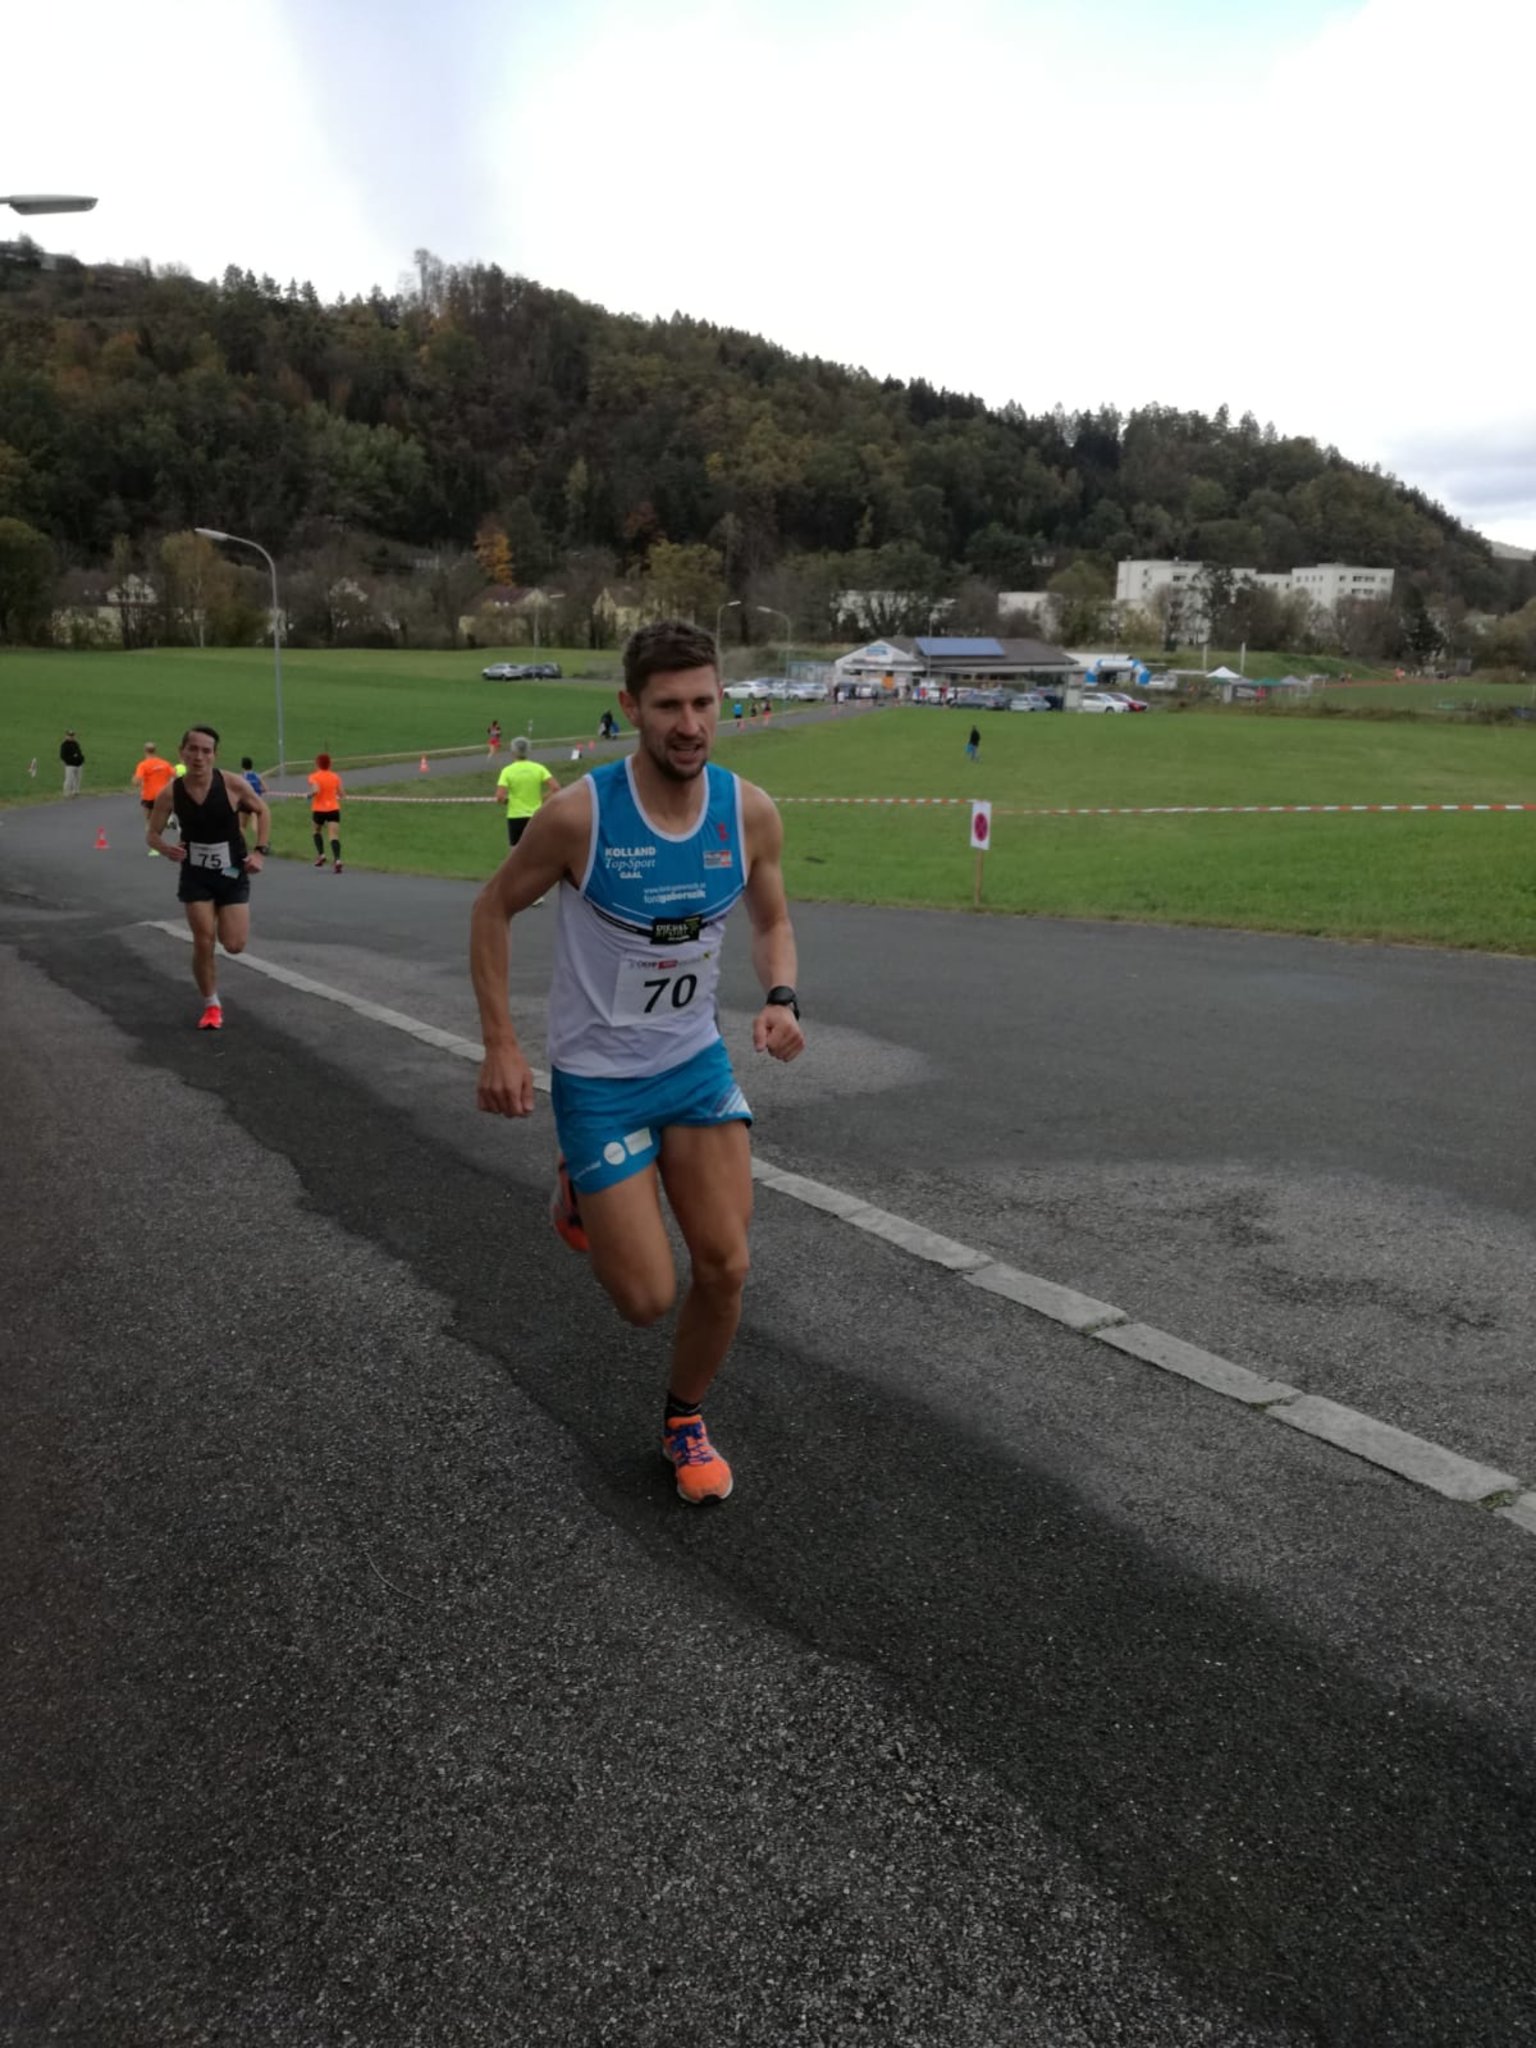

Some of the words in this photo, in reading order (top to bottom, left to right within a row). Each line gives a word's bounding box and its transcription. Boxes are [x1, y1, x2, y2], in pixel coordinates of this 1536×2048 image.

[604, 846, 656, 857] KOLLAND
[198, 853, 222, 868] 75
[605, 858, 656, 871] Top-Sport
[619, 871, 643, 879] GAAL
[643, 973, 697, 1015] 70
